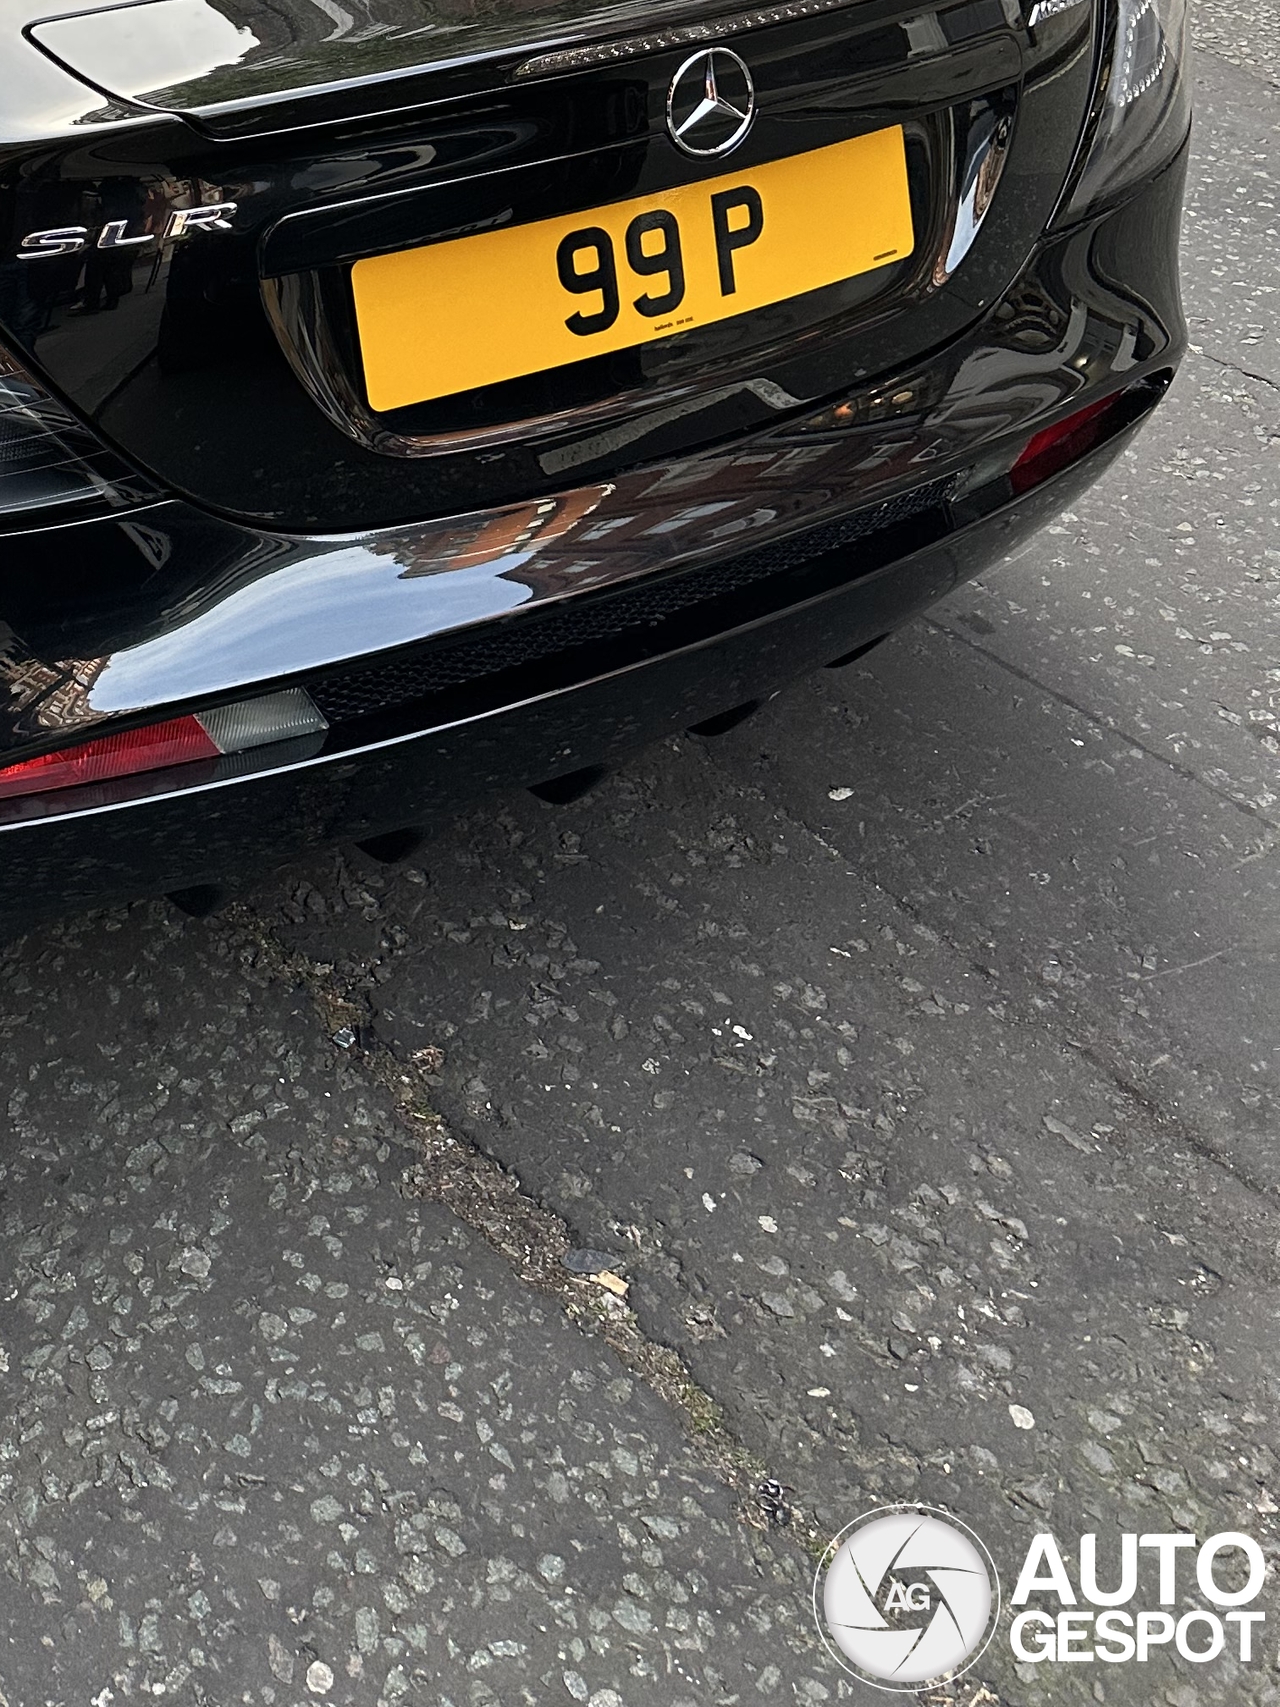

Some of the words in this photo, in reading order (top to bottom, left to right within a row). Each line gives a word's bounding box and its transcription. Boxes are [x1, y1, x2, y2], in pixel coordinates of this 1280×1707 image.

[16, 202, 238, 260] SLR
[556, 209, 686, 337] 99
[710, 185, 764, 297] P
